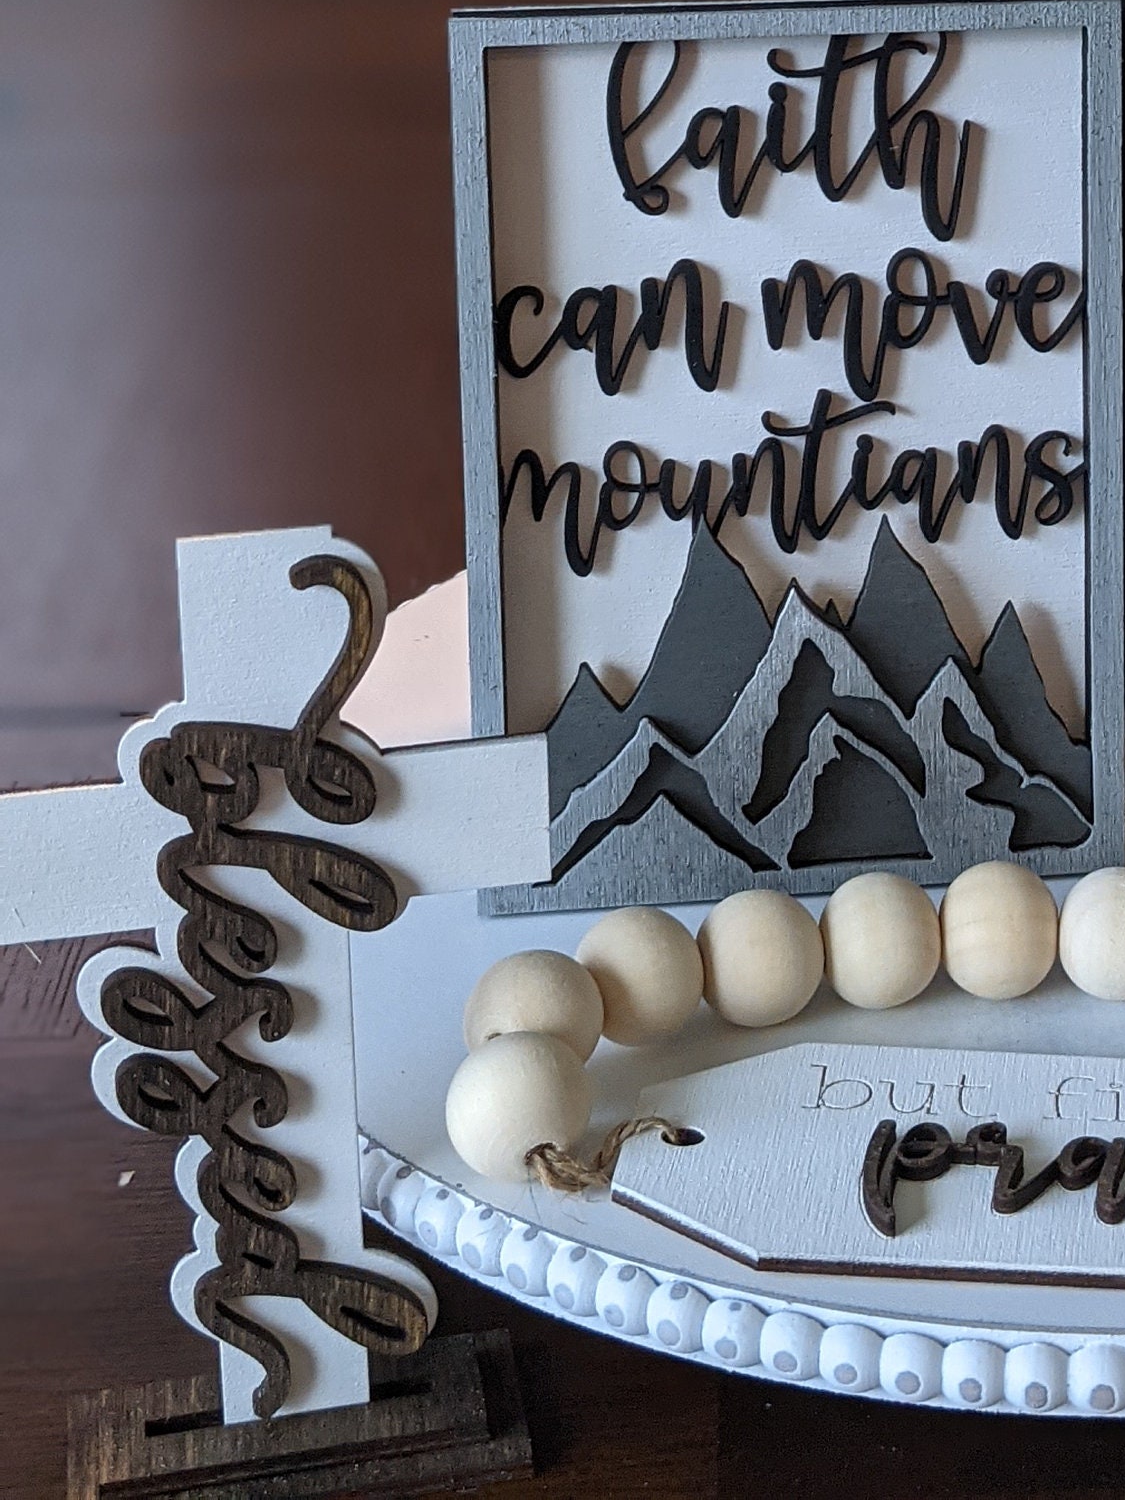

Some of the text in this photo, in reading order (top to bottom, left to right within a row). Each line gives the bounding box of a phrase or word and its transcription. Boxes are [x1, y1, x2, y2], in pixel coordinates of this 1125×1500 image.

[605, 30, 972, 242] faith
[496, 246, 1086, 402] can move
[100, 553, 426, 1422] blessed
[802, 1062, 1000, 1120] but
